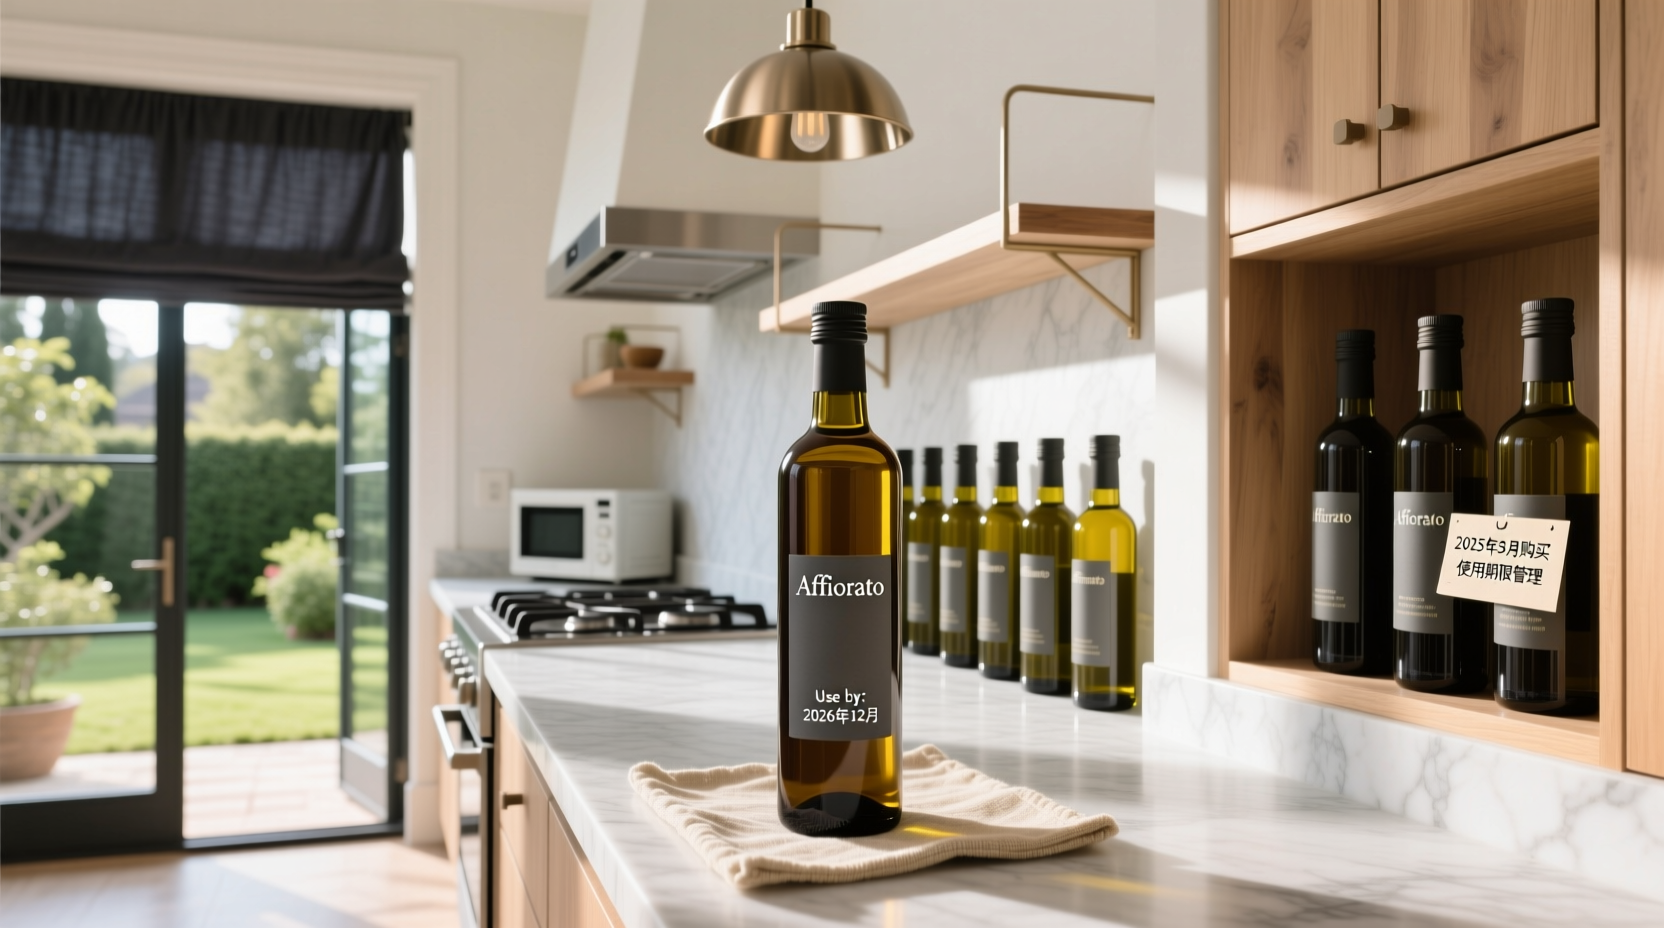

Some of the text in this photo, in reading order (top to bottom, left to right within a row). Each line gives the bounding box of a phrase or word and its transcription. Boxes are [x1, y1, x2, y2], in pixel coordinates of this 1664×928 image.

[1454, 536, 1551, 561] 2025年3月购买
[1456, 558, 1544, 586] 使用期限管理
[795, 573, 885, 597] Affiorato
[815, 688, 866, 707] Use by:
[803, 707, 878, 725] 2026年12月
